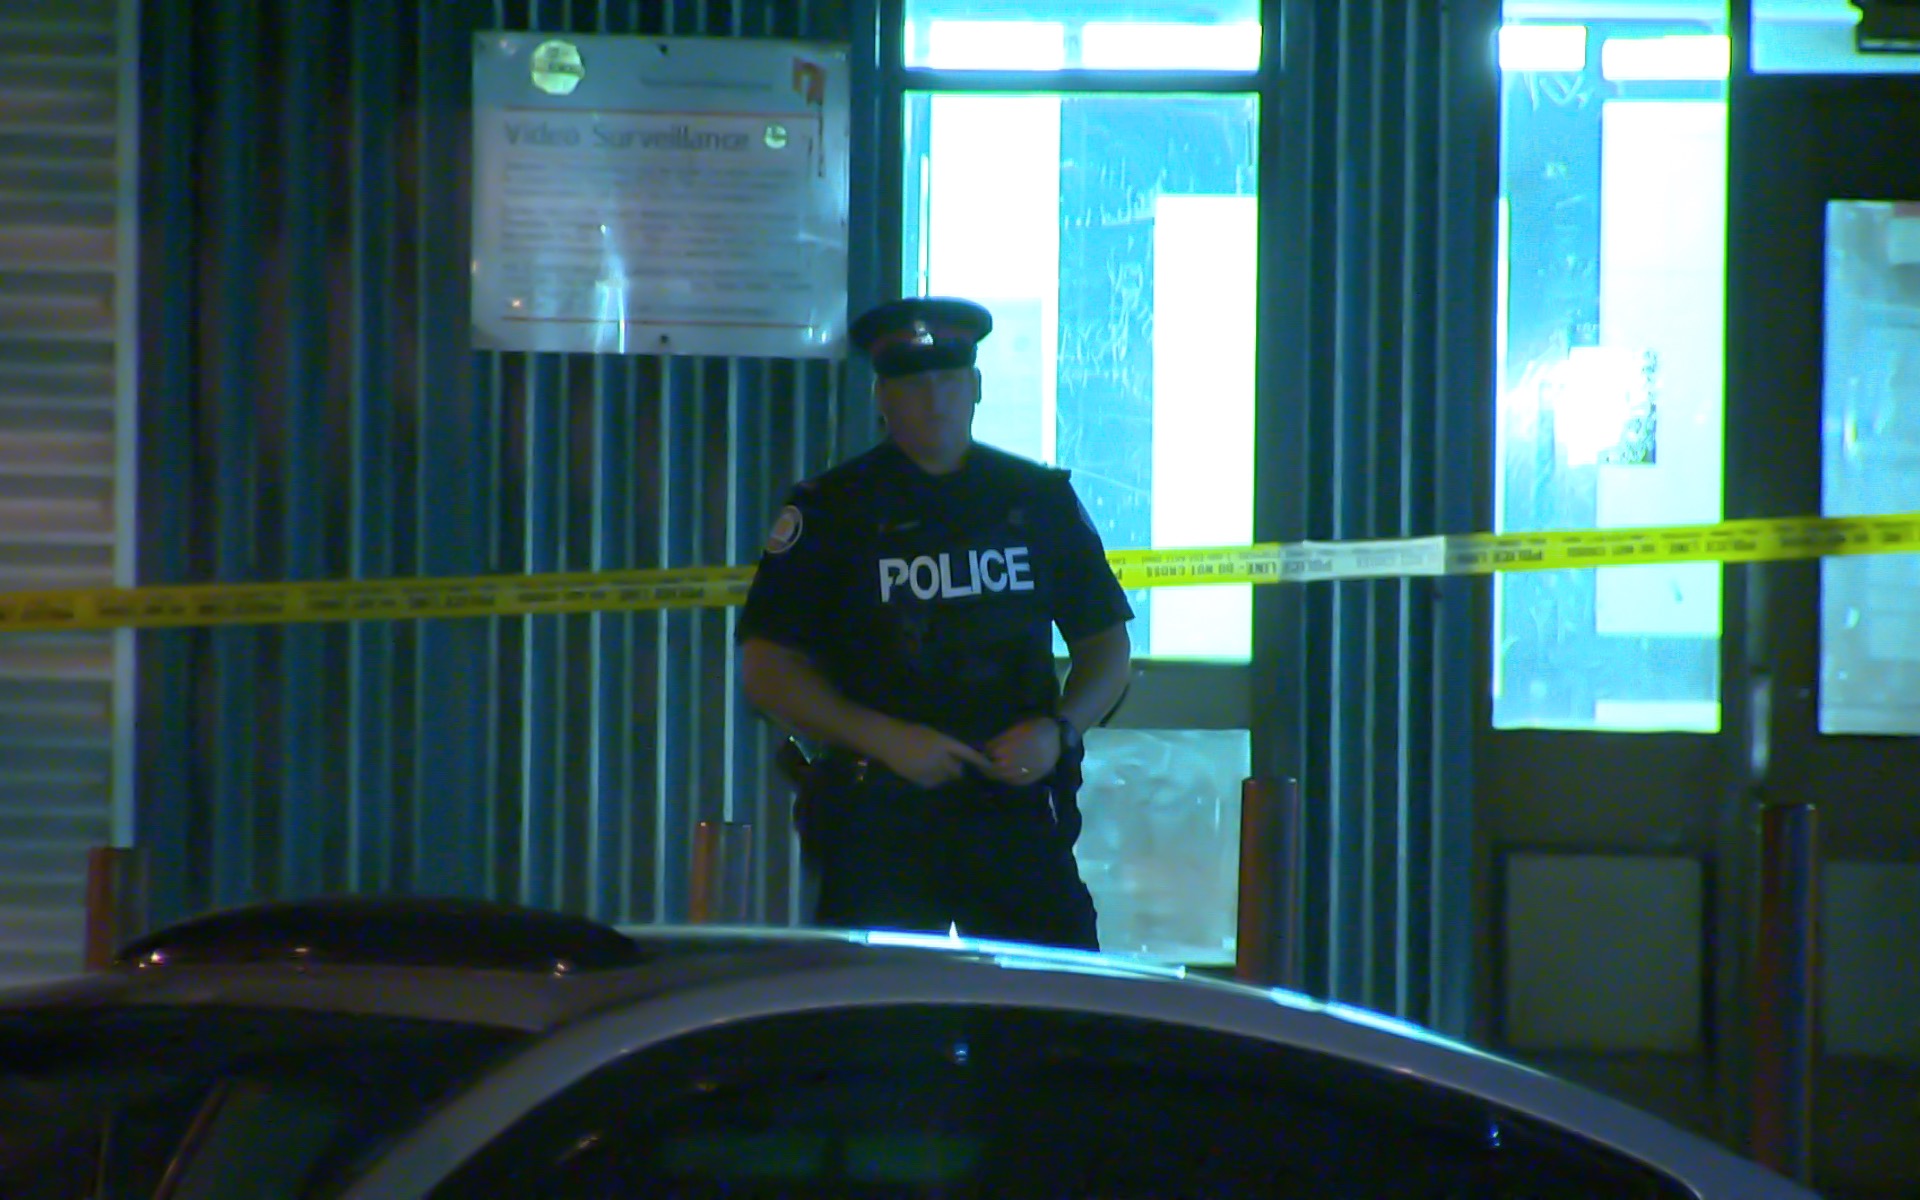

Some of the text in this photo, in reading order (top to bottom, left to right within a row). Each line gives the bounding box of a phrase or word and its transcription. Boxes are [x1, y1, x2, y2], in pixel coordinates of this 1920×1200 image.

[504, 122, 749, 149] Video Surveillance
[878, 547, 1035, 602] POLICE
